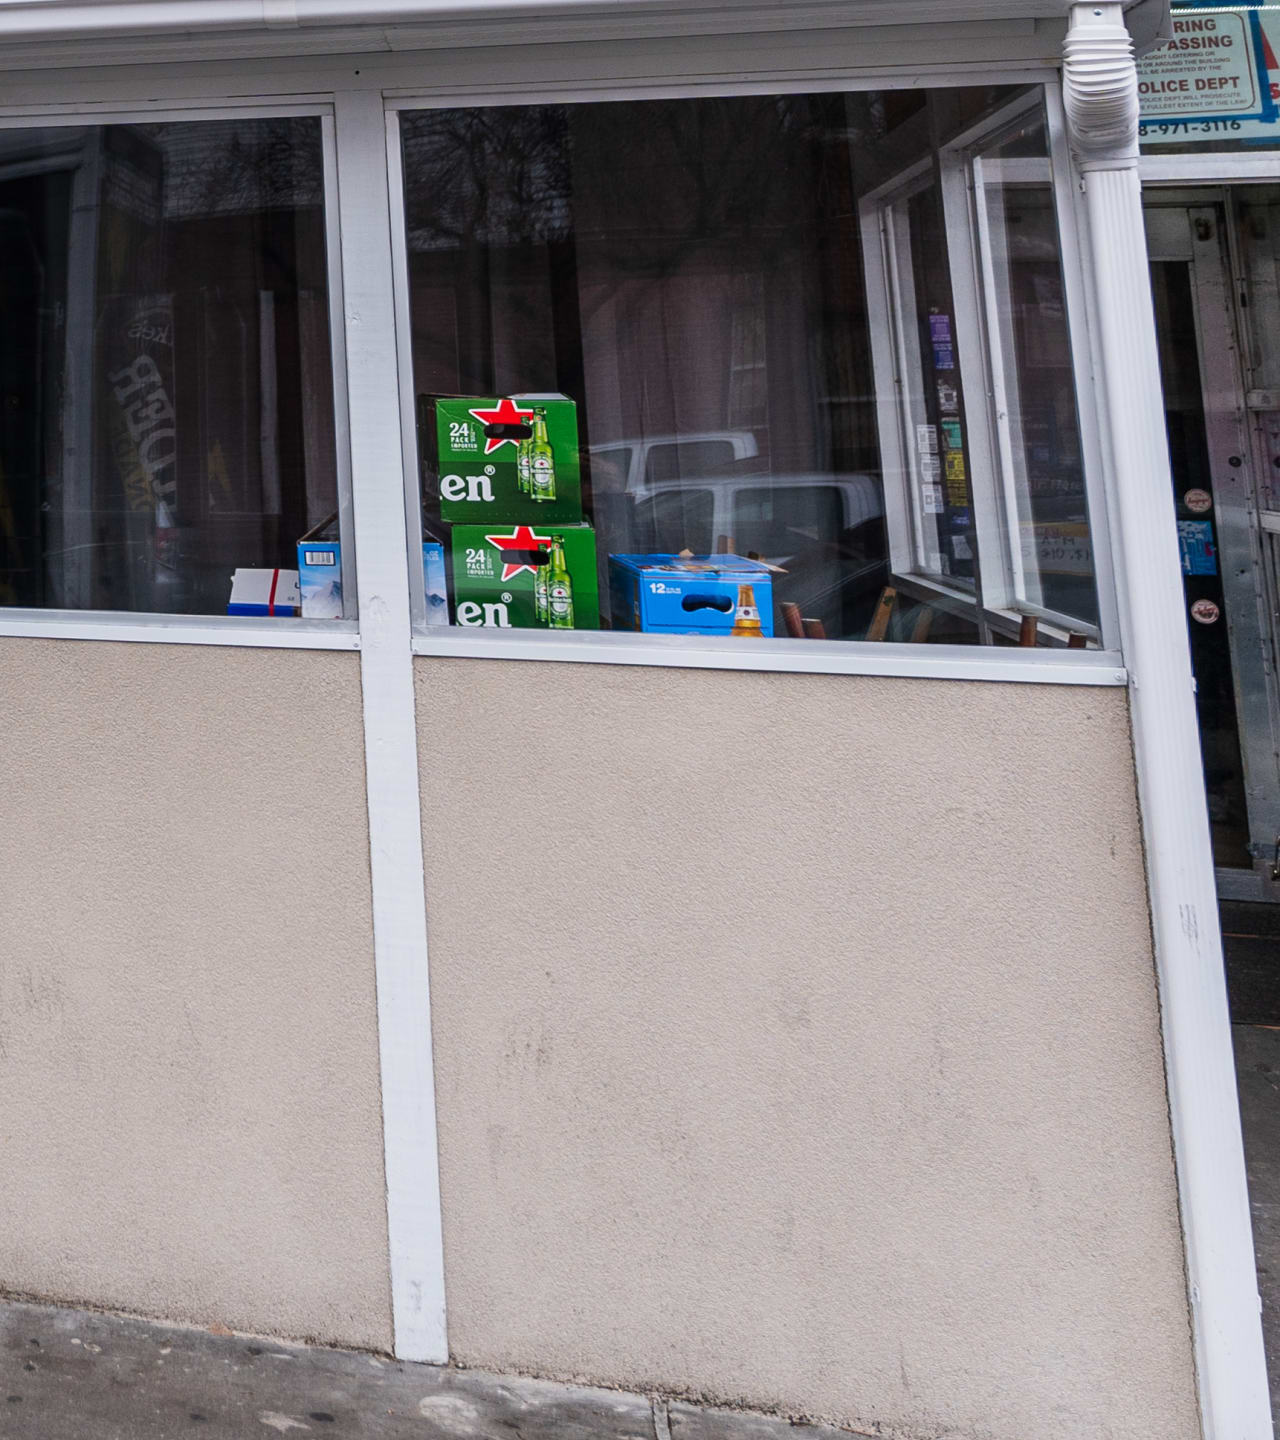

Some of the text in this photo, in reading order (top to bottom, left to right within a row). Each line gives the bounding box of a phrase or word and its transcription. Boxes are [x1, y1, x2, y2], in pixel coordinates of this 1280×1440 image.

[1173, 19, 1216, 33] RING
[1157, 35, 1233, 52] ASSING
[1138, 76, 1240, 94] OLICE DEPT
[1138, 120, 1241, 137] 8-971-3116
[449, 422, 469, 437] 24
[440, 473, 496, 502] en
[465, 548, 485, 563] 24
[649, 583, 666, 594] 12
[456, 601, 512, 628] en
